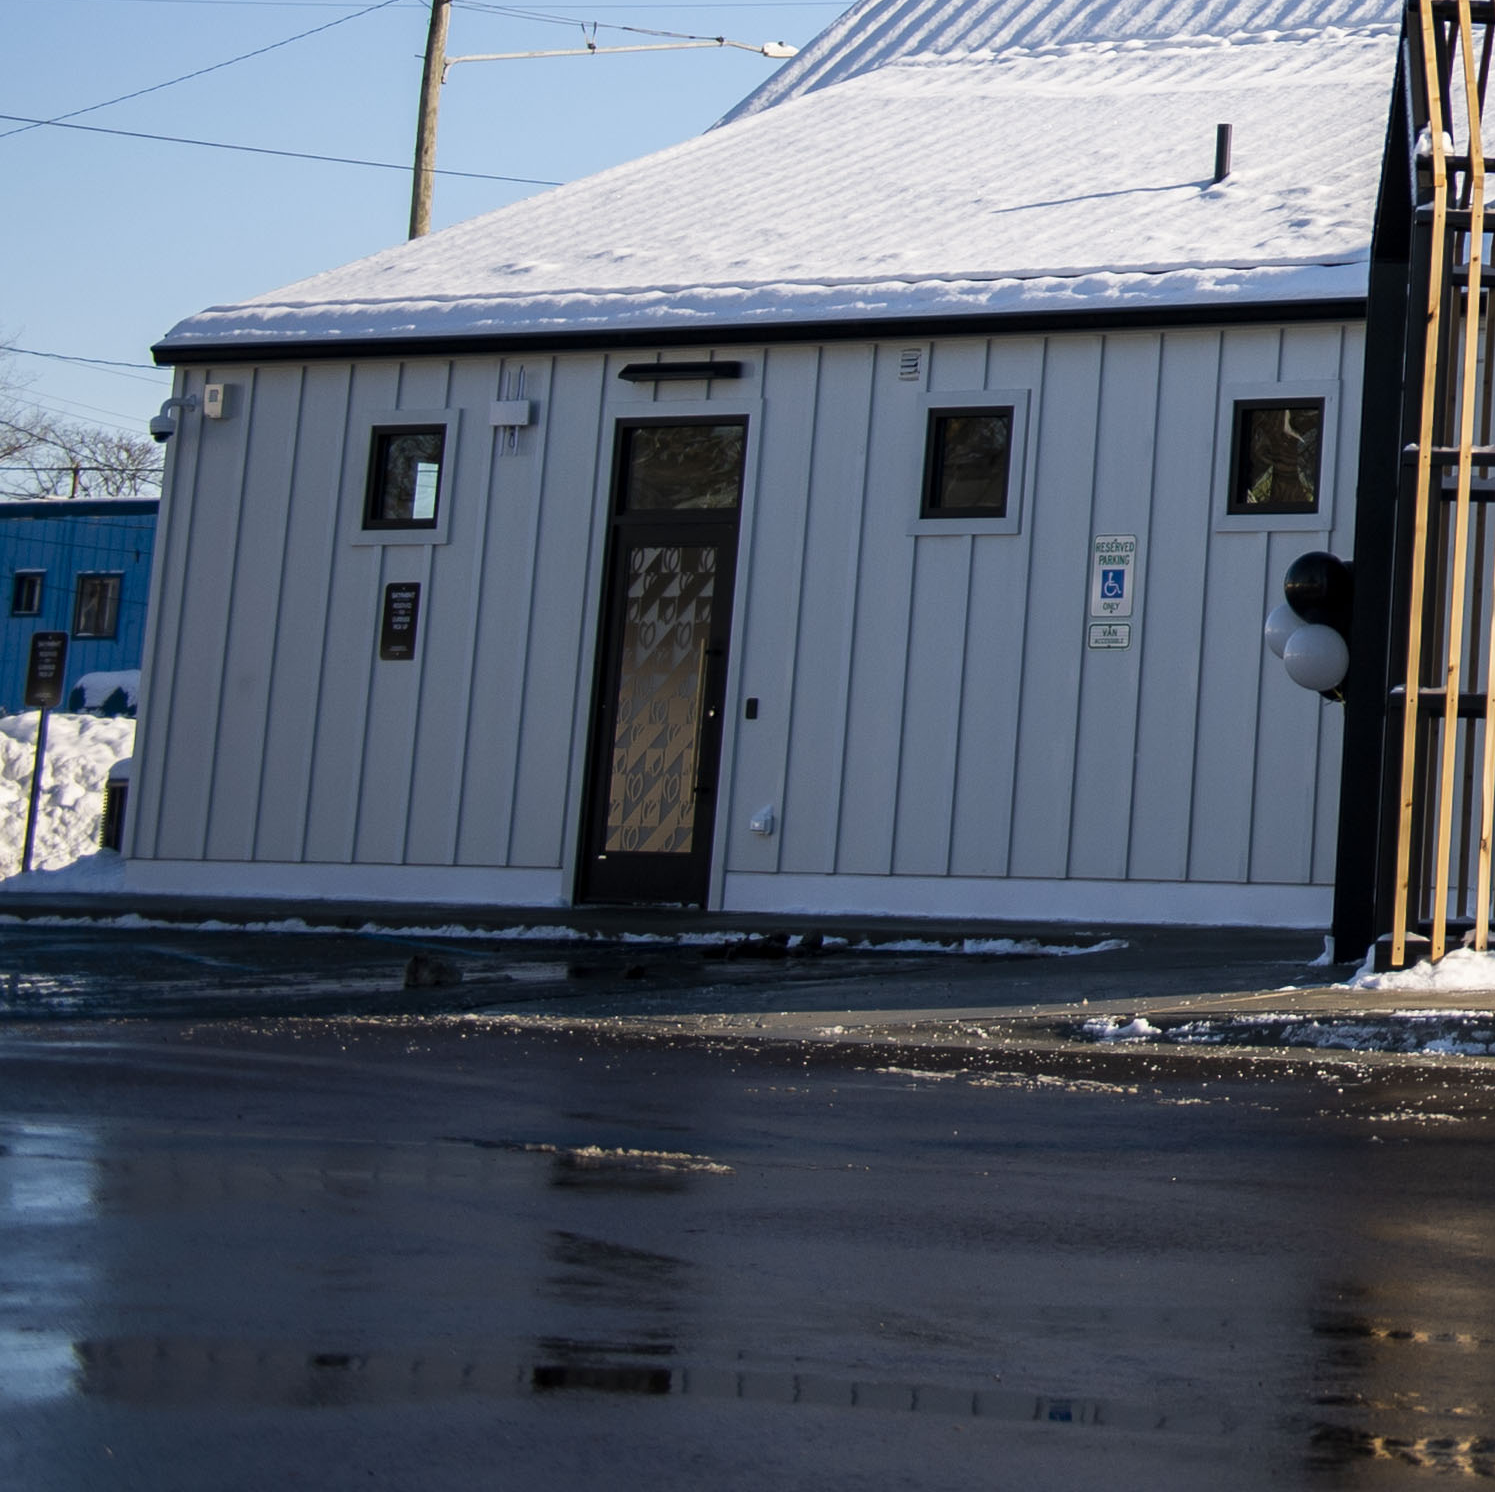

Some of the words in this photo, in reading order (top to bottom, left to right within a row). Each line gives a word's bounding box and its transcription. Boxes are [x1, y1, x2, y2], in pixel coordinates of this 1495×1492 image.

[1096, 541, 1135, 553] RESERVED
[1098, 554, 1130, 566] PARKING
[1102, 602, 1120, 611] ONLY
[1102, 628, 1118, 637] VAN
